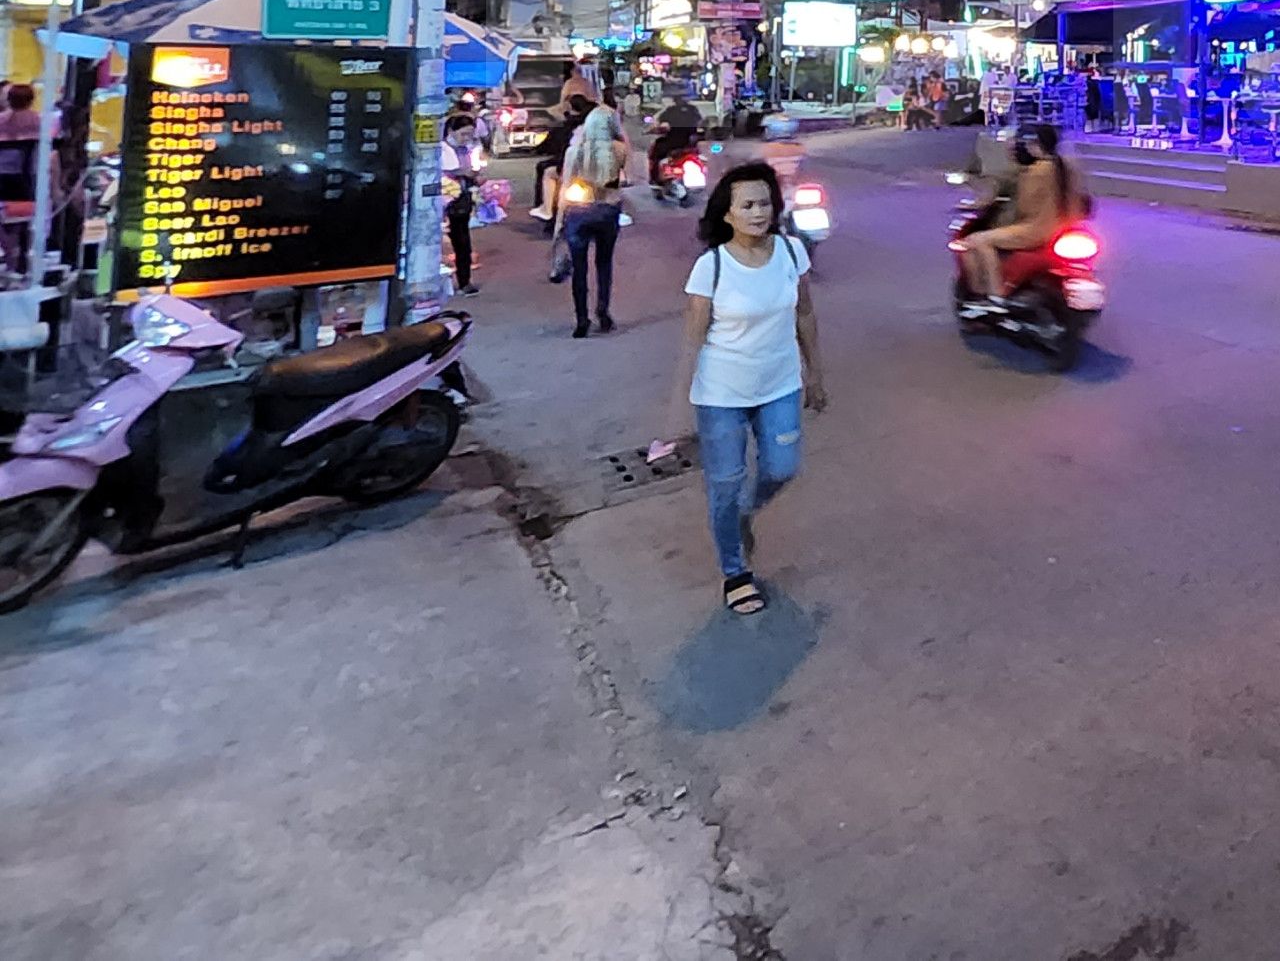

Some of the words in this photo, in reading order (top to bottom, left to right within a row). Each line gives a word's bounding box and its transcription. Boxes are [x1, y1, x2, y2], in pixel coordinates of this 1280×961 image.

[149, 105, 225, 120] Singha
[148, 121, 224, 136] Singha
[232, 119, 283, 134] Light
[147, 137, 217, 152] Chang
[146, 152, 205, 167] Tiger
[145, 168, 204, 184] Tiger
[210, 165, 264, 180] Light
[144, 200, 186, 214] San
[193, 195, 263, 212] Miguel
[138, 263, 183, 279] Spy
